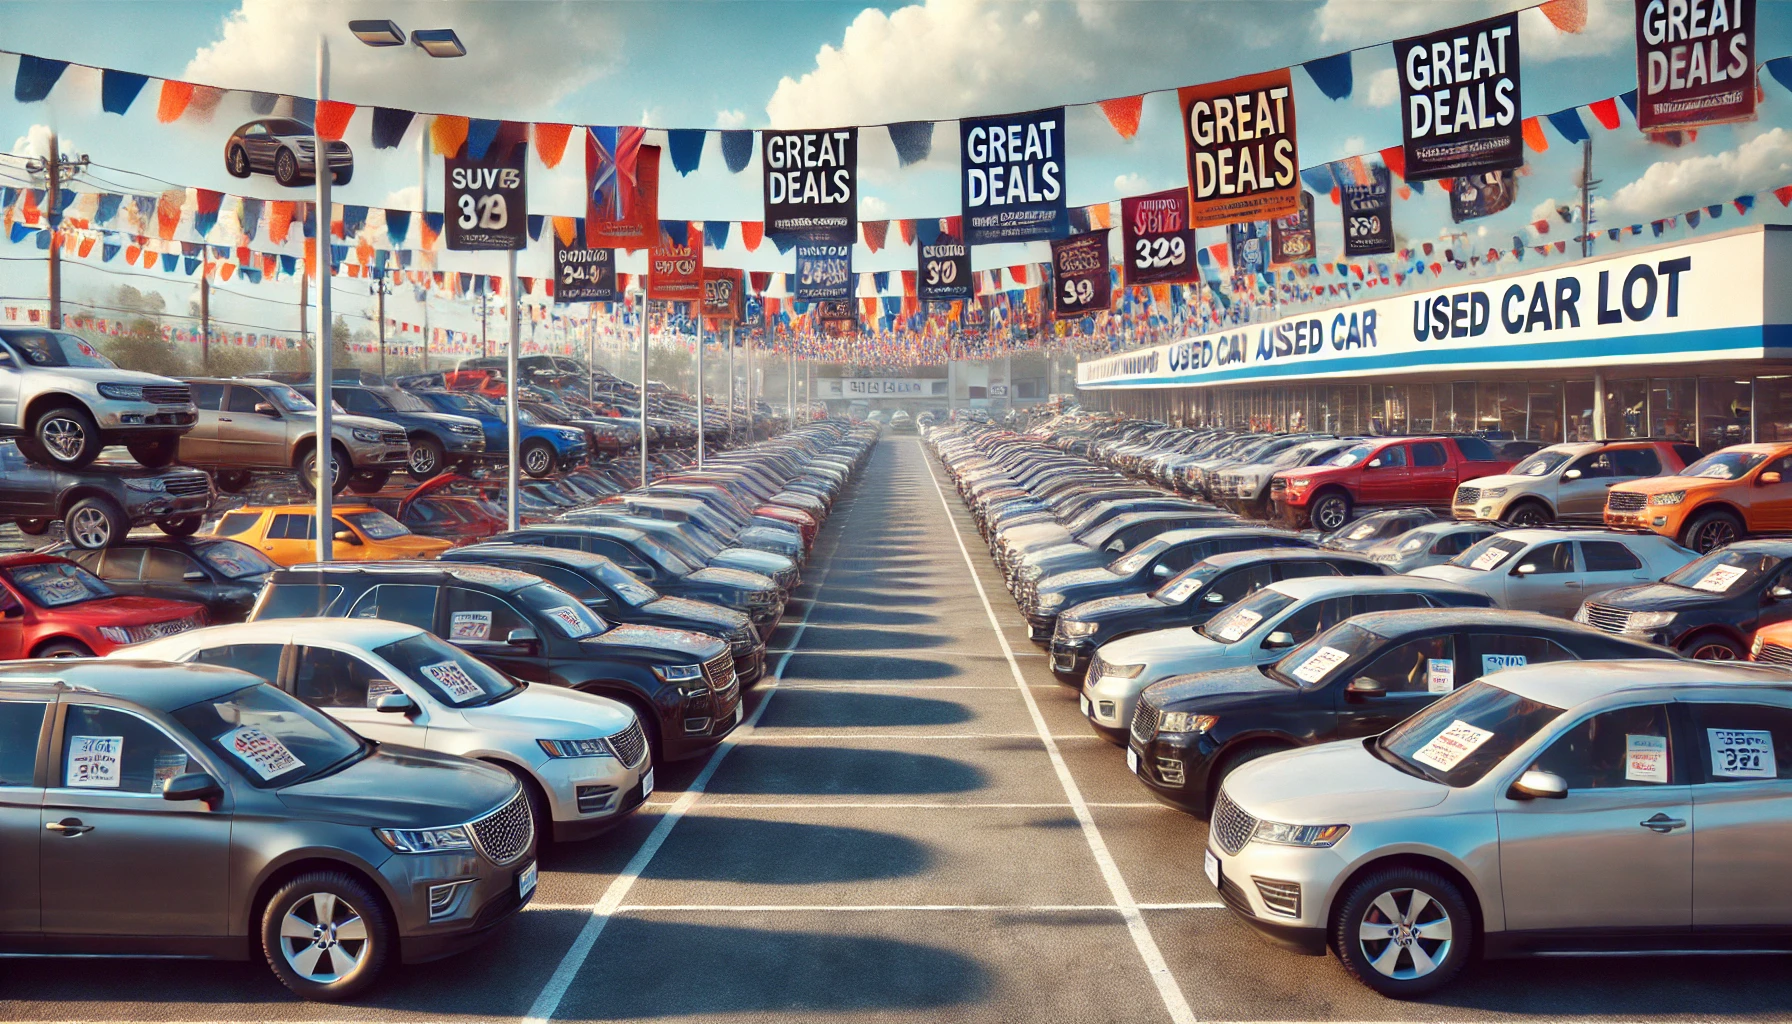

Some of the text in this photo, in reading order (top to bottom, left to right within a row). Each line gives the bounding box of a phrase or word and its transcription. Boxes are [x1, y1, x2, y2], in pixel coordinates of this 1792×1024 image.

[1642, 0, 1743, 46] GREAT
[1405, 25, 1511, 91] GREAT
[1647, 32, 1748, 96] DEALS
[1190, 86, 1289, 147] GREAT
[1409, 77, 1515, 139] DEALS
[766, 131, 850, 169] GREAT
[967, 120, 1056, 164] GREAT
[768, 169, 851, 205] DEALS
[967, 161, 1061, 207] DEALS
[1195, 138, 1296, 199] DEALS
[1135, 236, 1186, 269] 329
[1413, 255, 1692, 342] USED CAR LOT
[1330, 308, 1378, 350] CAR
